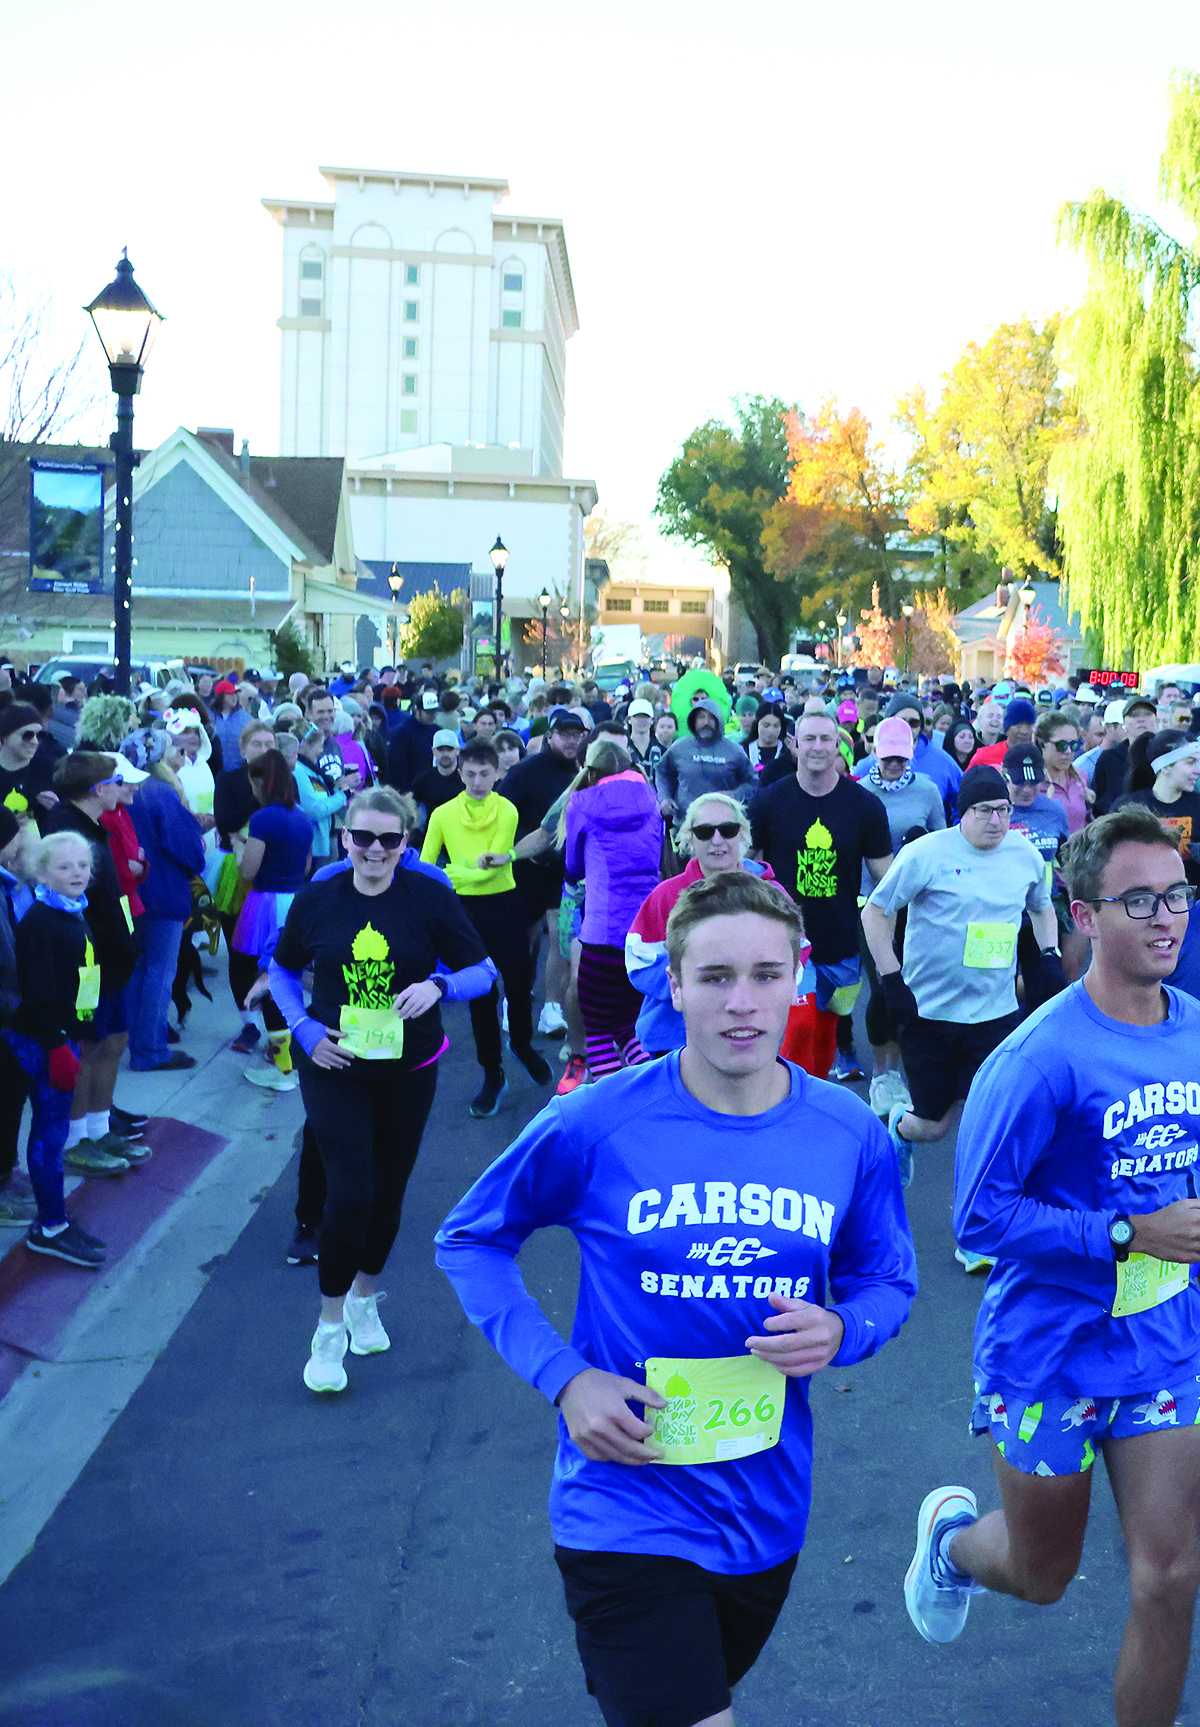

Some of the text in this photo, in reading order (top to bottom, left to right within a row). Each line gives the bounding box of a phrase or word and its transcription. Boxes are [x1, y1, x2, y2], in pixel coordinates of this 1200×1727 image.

[1089, 670, 1138, 687] 8:0008
[797, 849, 837, 865] NEVADA
[813, 859, 837, 875] DAY
[797, 865, 838, 889] CLASSIC
[987, 940, 1012, 954] 337
[342, 961, 395, 983] NEVADA
[366, 1029, 396, 1044] 194
[1111, 1143, 1199, 1180] SENATORS
[627, 1182, 835, 1245] CARSON
[641, 1271, 811, 1299] SENATORS
[670, 1407, 696, 1422] DAY
[704, 1394, 775, 1431] 266
[655, 1415, 697, 1438] CLASSIC
